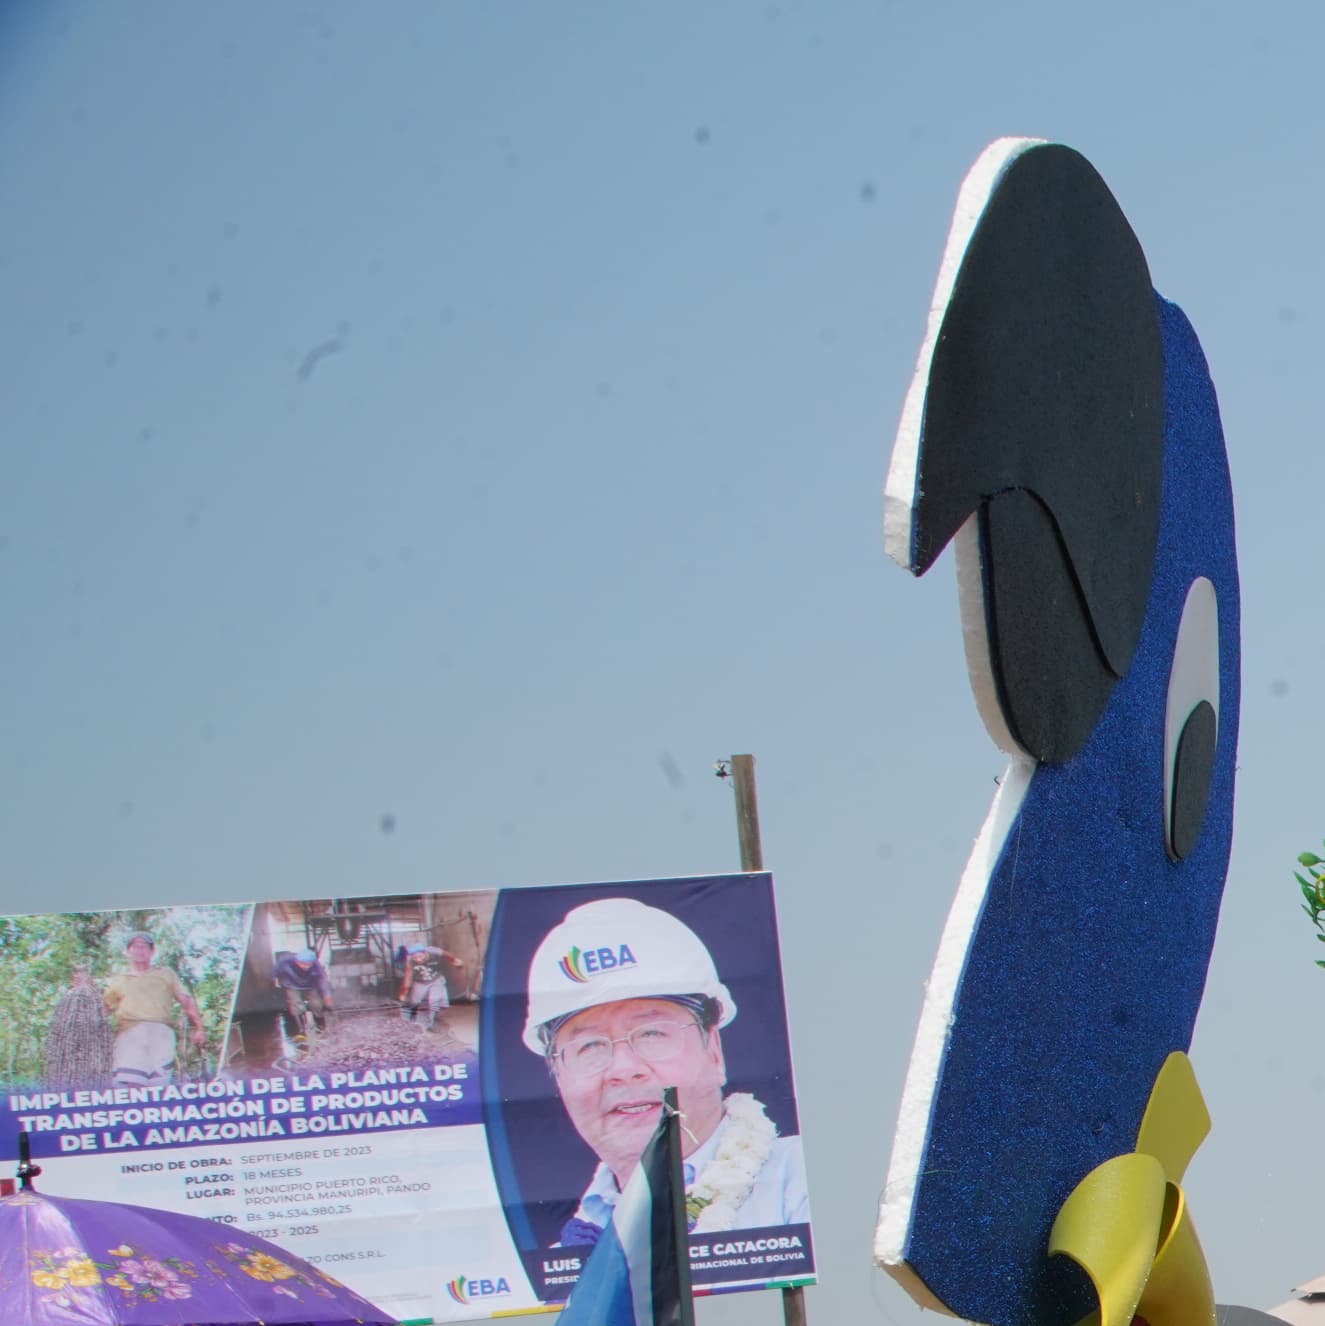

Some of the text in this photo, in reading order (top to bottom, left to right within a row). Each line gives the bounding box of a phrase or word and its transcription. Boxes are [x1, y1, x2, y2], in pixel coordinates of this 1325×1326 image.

[582, 944, 637, 973] EBA
[10, 1062, 469, 1112] IMPLEMENTACIÓN DE LA PLANTA DE
[18, 1084, 464, 1134] TRANSFORMACIÓN DE PRODUCTOS
[60, 1108, 429, 1153] DE LA AMAZONÍA BOLIVIANA
[121, 1145, 373, 1175] INICIO DE OBRA: SEPTIEMBRE DE 2023
[184, 1167, 303, 1186] PLAZO: 18 MESES
[186, 1187, 236, 1201] LUGAR:
[244, 1182, 313, 1197] MUNICIPIO
[315, 1177, 367, 1191] PUERTO
[244, 1191, 315, 1206] PROVINCIA
[387, 1181, 432, 1195] PANDO
[289, 1225, 319, 1237] 2025
[544, 1236, 803, 1273] LUIS CE CATACORA
[750, 1256, 764, 1264] DE
[766, 1252, 805, 1263] BOLIVIA
[467, 1277, 512, 1296] EBA
